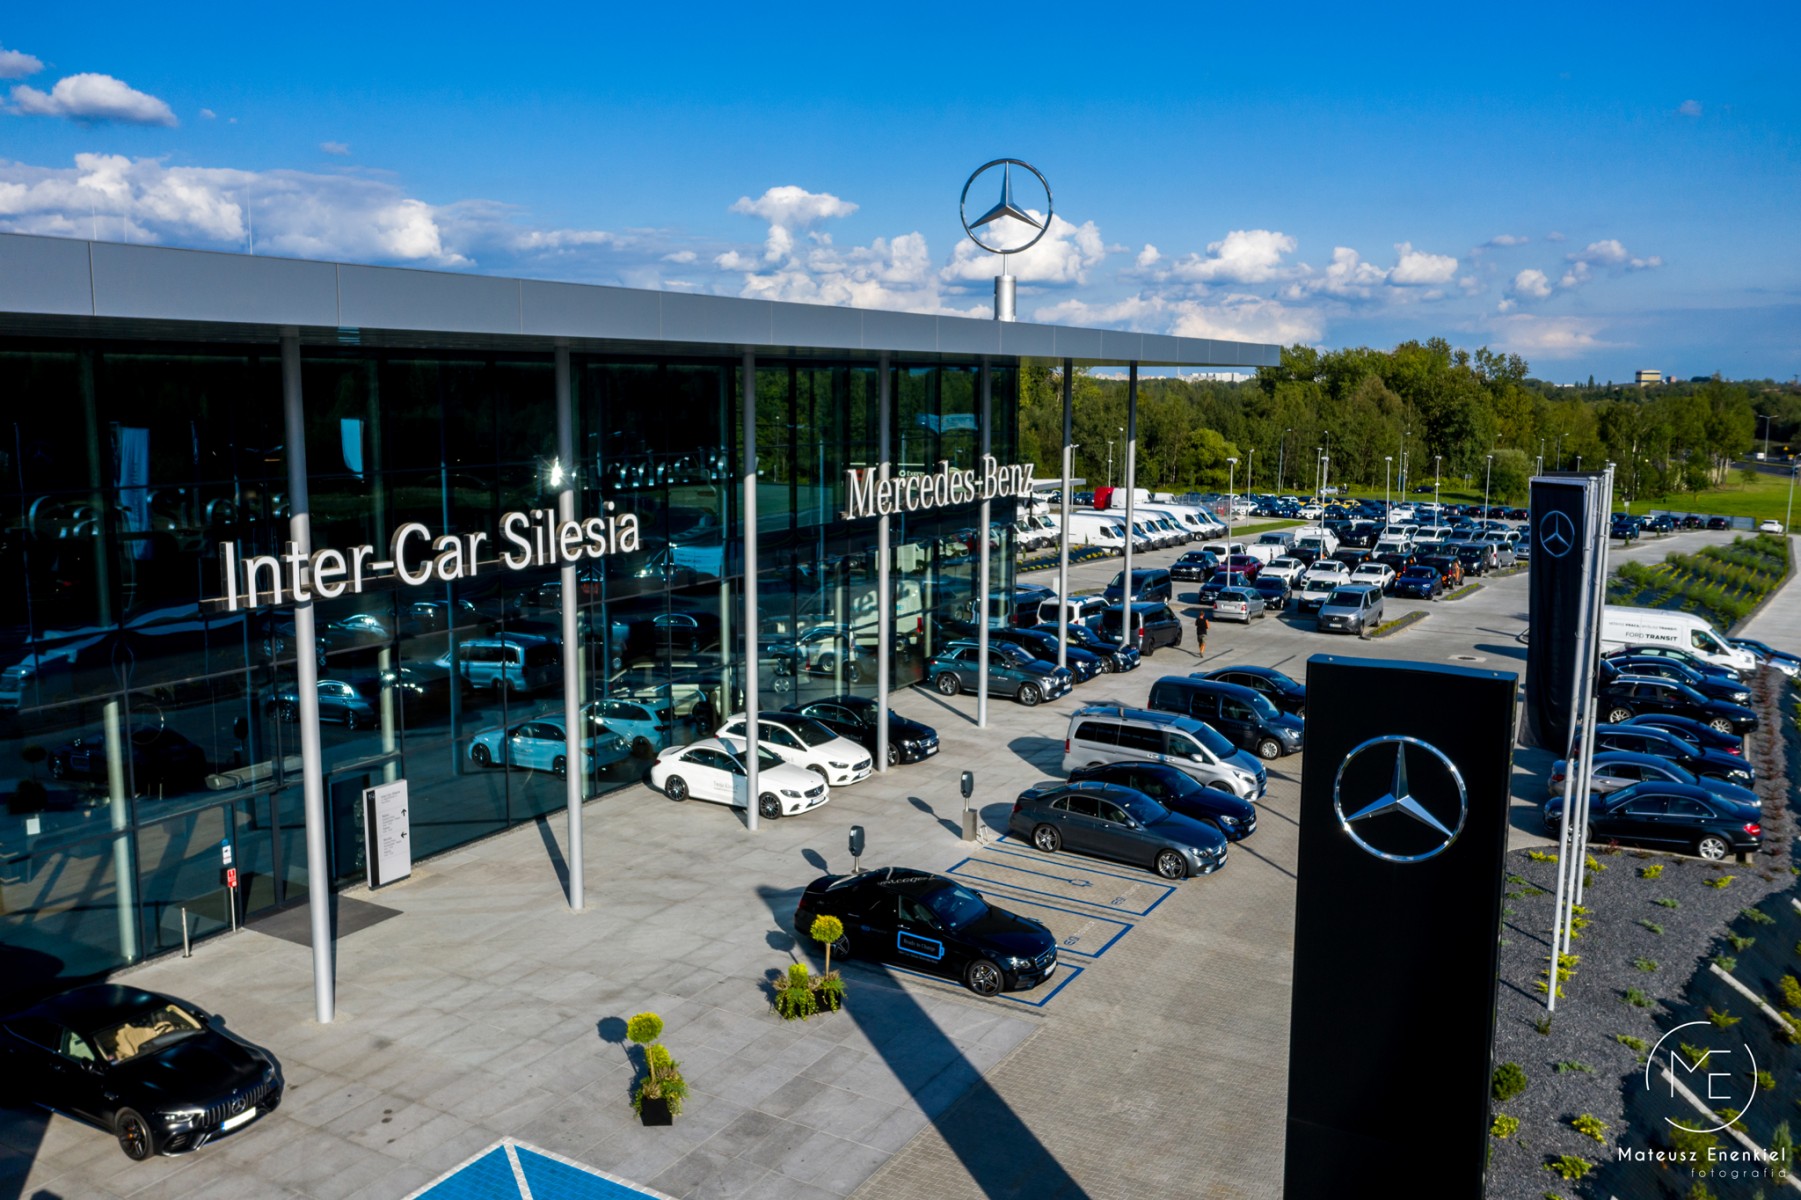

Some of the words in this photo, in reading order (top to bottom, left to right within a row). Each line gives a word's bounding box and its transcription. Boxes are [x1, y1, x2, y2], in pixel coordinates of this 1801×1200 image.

[846, 456, 1035, 520] Mercedes-Benz
[220, 522, 487, 612] Inter-Car
[501, 501, 641, 571] Silesia
[1625, 631, 1645, 639] FORD
[1645, 633, 1678, 642] TRANSIT
